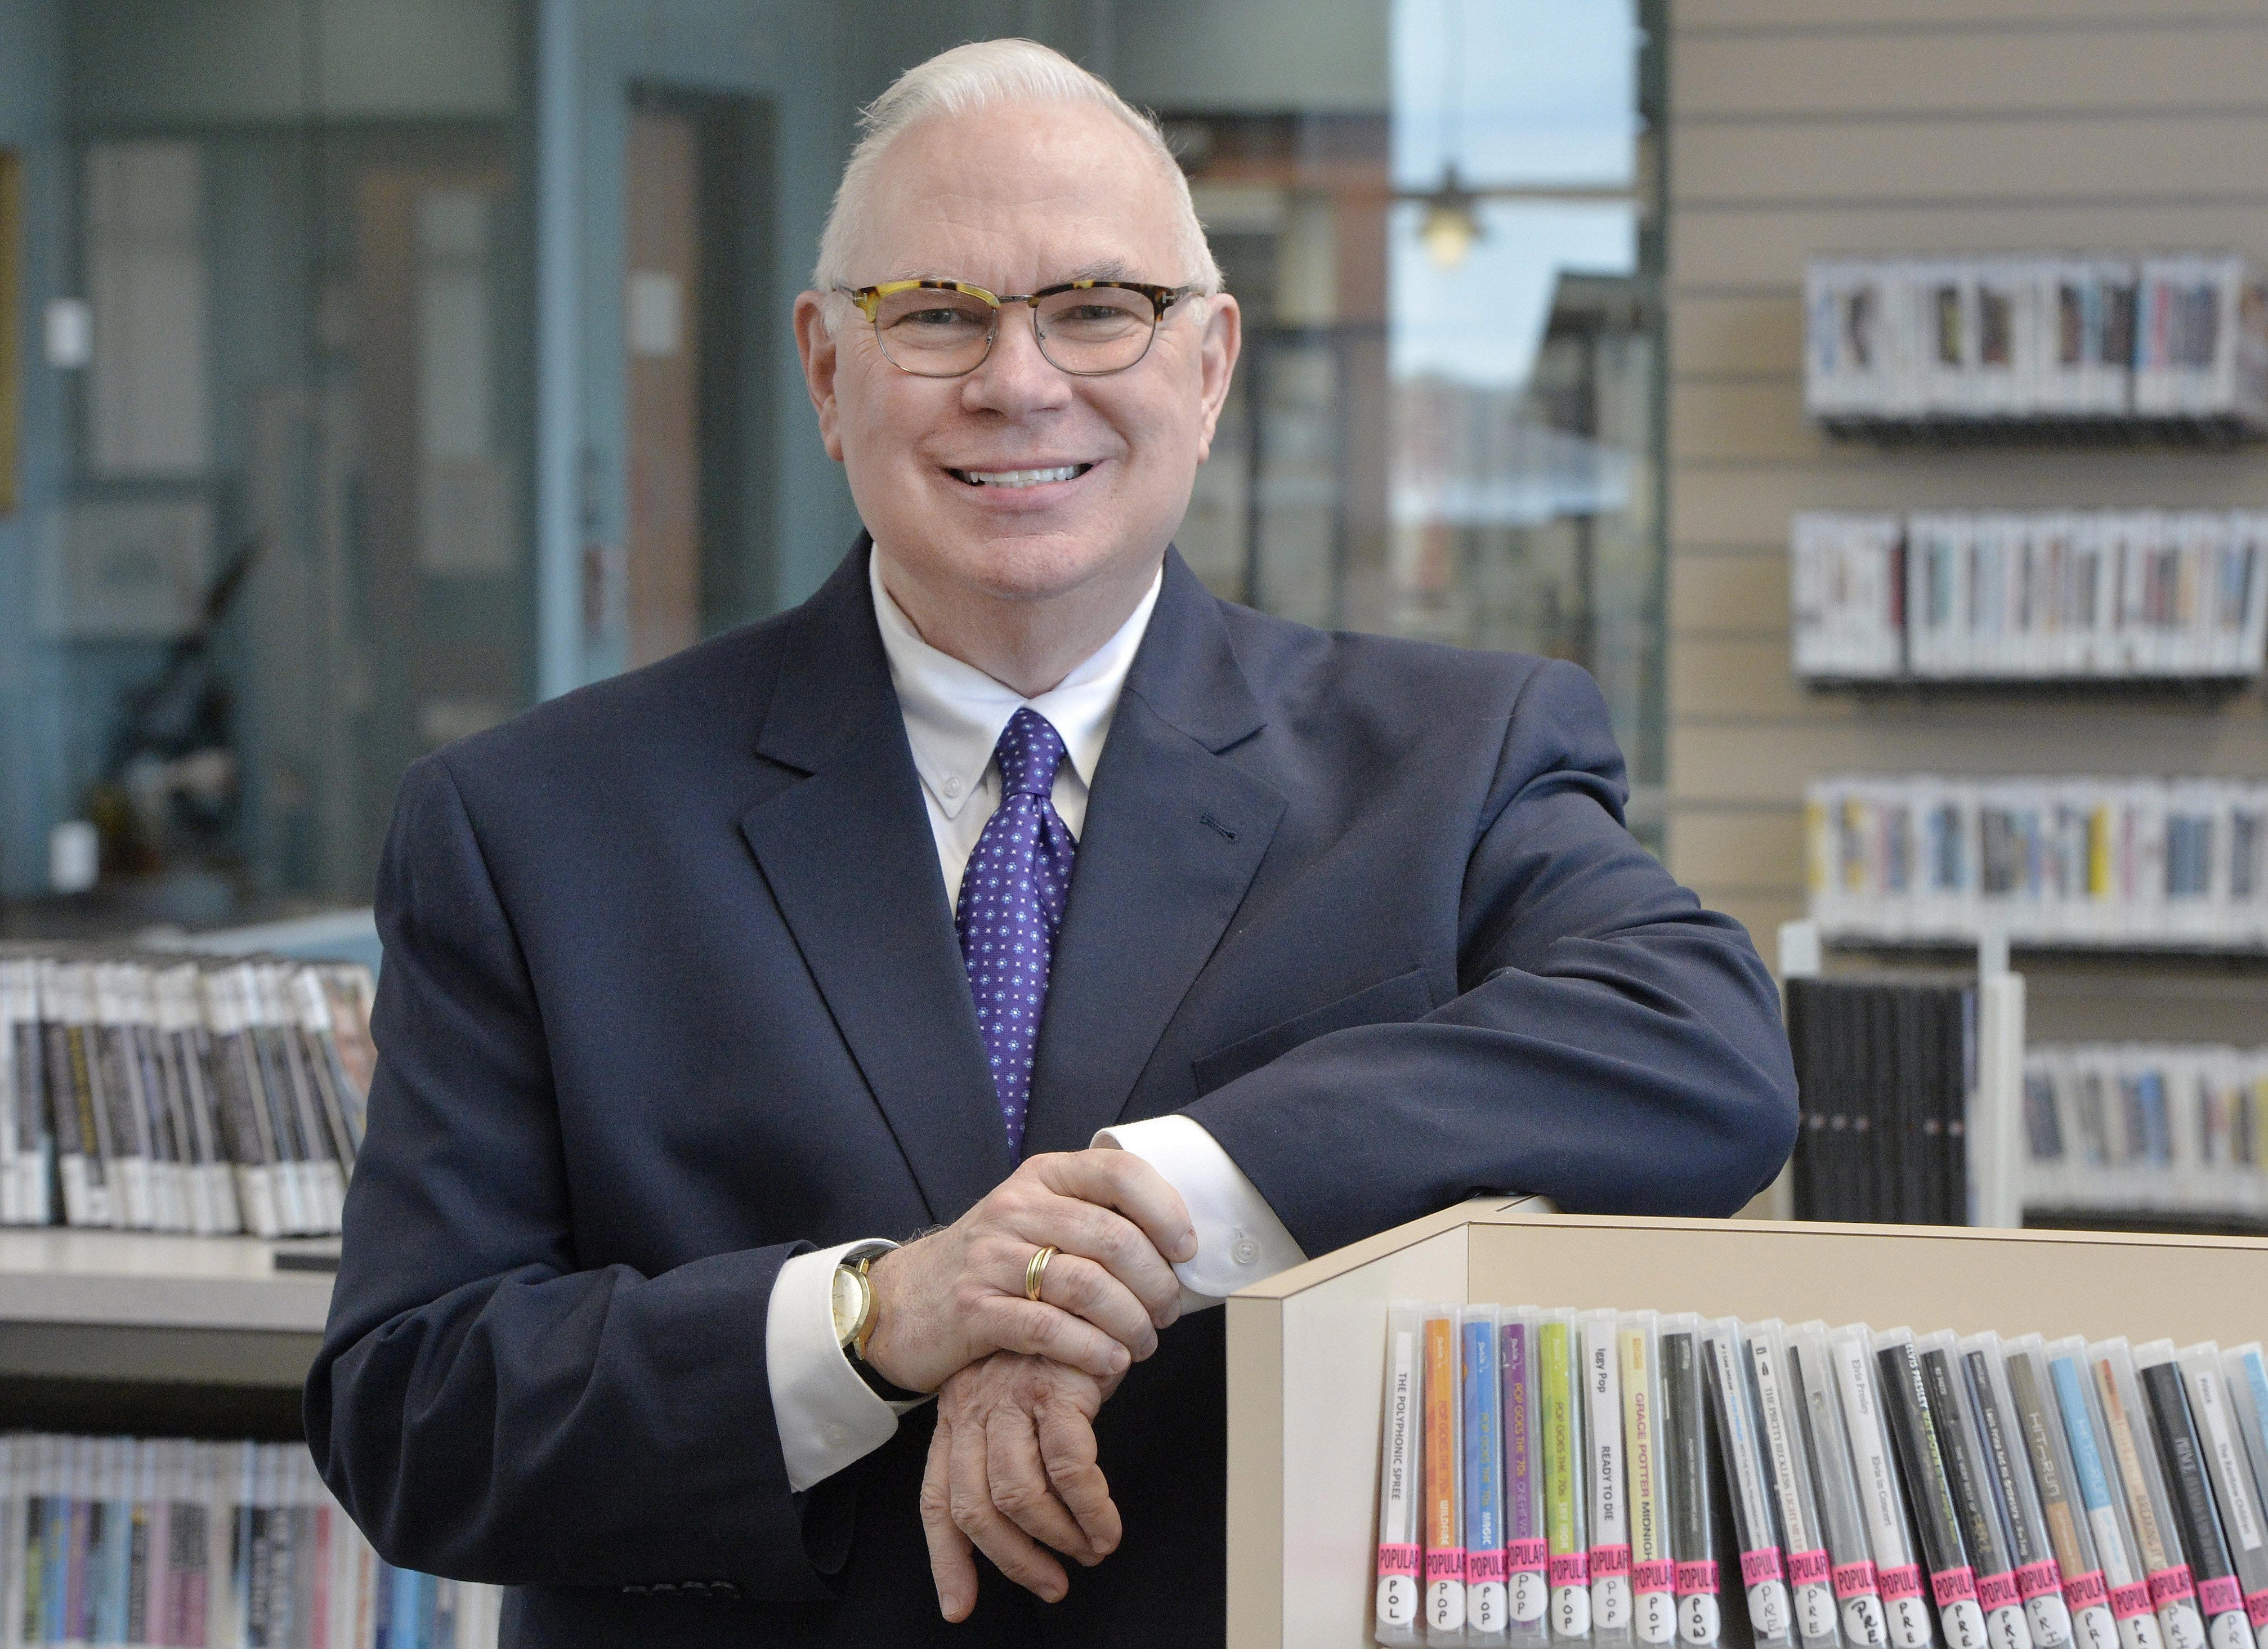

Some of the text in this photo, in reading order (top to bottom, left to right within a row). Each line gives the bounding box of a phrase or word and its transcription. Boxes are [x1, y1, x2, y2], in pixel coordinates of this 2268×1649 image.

[1595, 1348, 1607, 1393] Iggy Pop
[1852, 1359, 1863, 1381] Elvis
[1438, 1401, 1448, 1420] POP
[1514, 1383, 1523, 1402] POP
[1555, 1402, 1565, 1421] POP
[1392, 1373, 1407, 1500] THE POLYPHONIC SPREE
[1514, 1406, 1524, 1434] GOES
[1556, 1424, 1565, 1453] GOES
[1516, 1437, 1526, 1454] THE
[1558, 1456, 1567, 1472] THE
[1601, 1446, 1614, 1521] READY TO DIE
[1635, 1393, 1652, 1561] GRACE POTTER MIDNIGH
[1872, 1456, 1882, 1477] Elvis
[1482, 1512, 1492, 1545] MAGIC
[1389, 1580, 1399, 1618] POL
[1437, 1582, 1447, 1624] POP
[1481, 1587, 1491, 1624] POP
[1517, 1574, 1528, 1614] POP
[1563, 1588, 1573, 1629] POP
[1607, 1580, 1616, 1621] POP
[1762, 1585, 1782, 1632] PRE
[1808, 1589, 1819, 1633] PRE
[1649, 1597, 1659, 1635] POT
[1851, 1601, 1878, 1643] PRE
[1899, 1602, 1914, 1643] PRE
[1955, 1604, 1972, 1647] PRE
